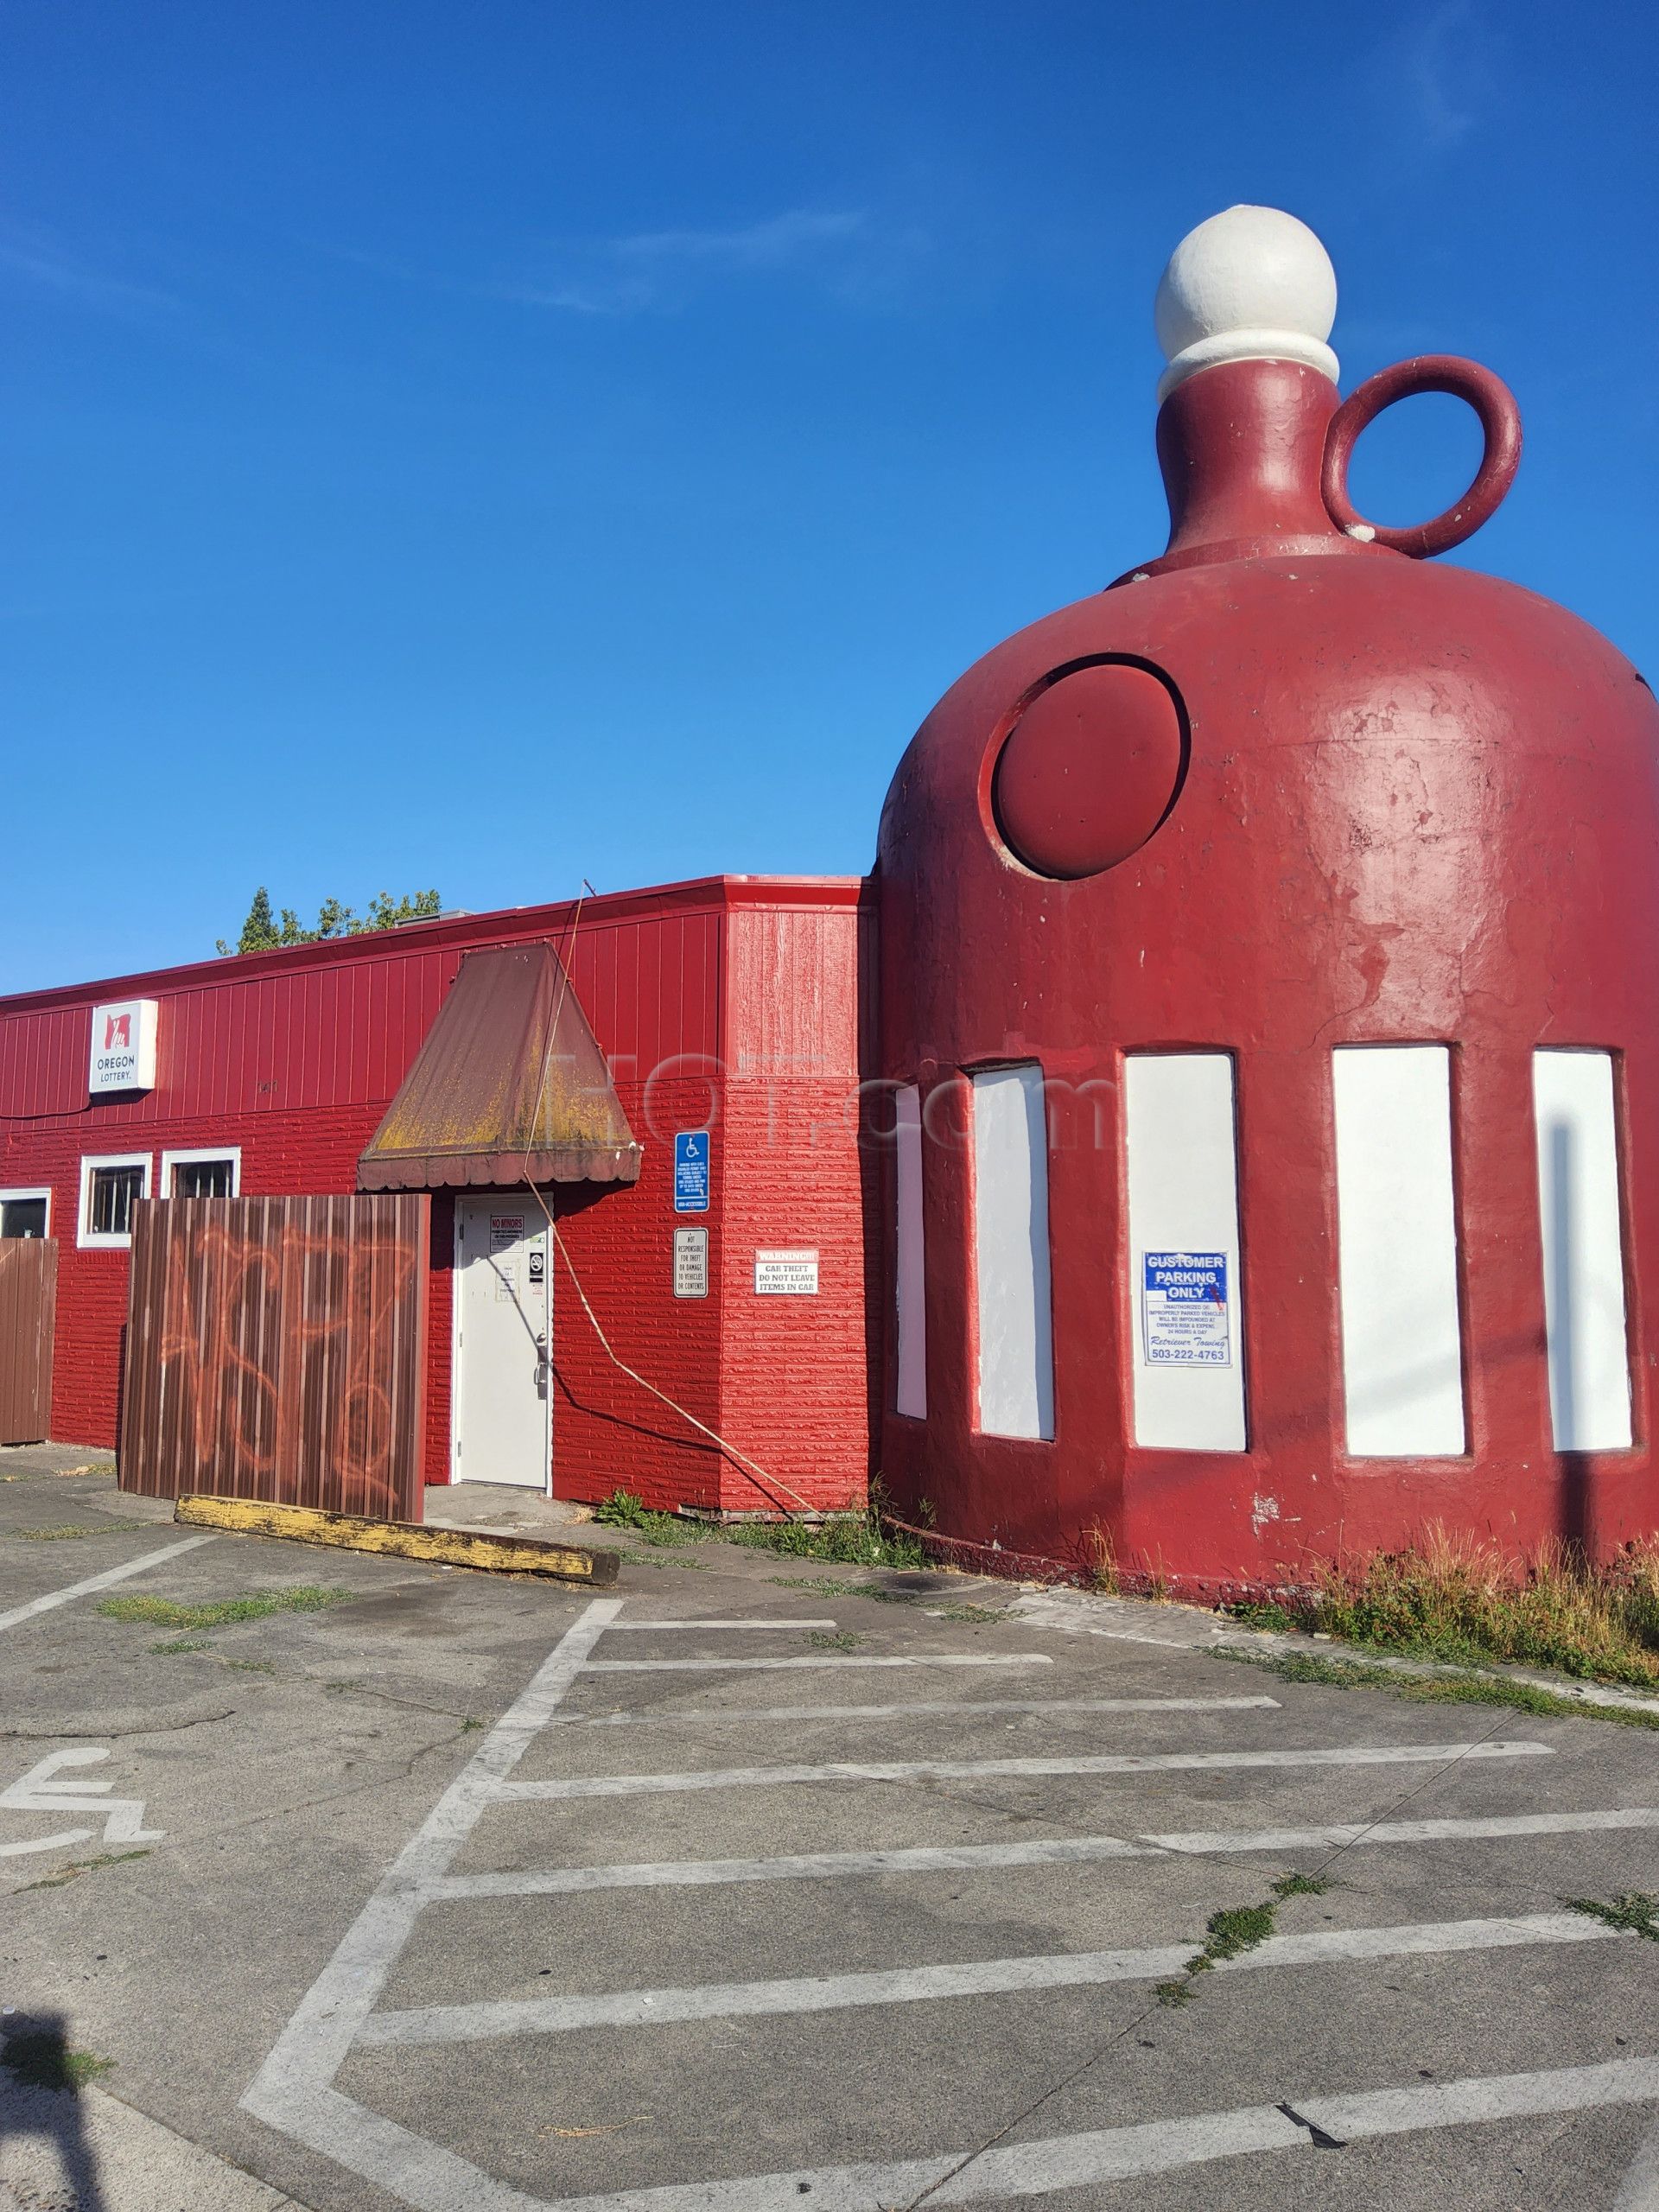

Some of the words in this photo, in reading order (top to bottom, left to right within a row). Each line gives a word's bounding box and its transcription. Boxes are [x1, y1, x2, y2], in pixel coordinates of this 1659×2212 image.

[97, 1055, 135, 1070] OREGON
[100, 1071, 130, 1083] LOTTERY
[493, 1218, 499, 1228] NO
[501, 1218, 522, 1228] MINORS
[1147, 1255, 1224, 1268] CUSTOMER
[1155, 1271, 1217, 1283] PARKING
[1167, 1287, 1205, 1299] ONLY
[1150, 1336, 1191, 1346] Retriever
[1193, 1337, 1225, 1350] Towing
[1152, 1349, 1224, 1360] 503-222-4763
